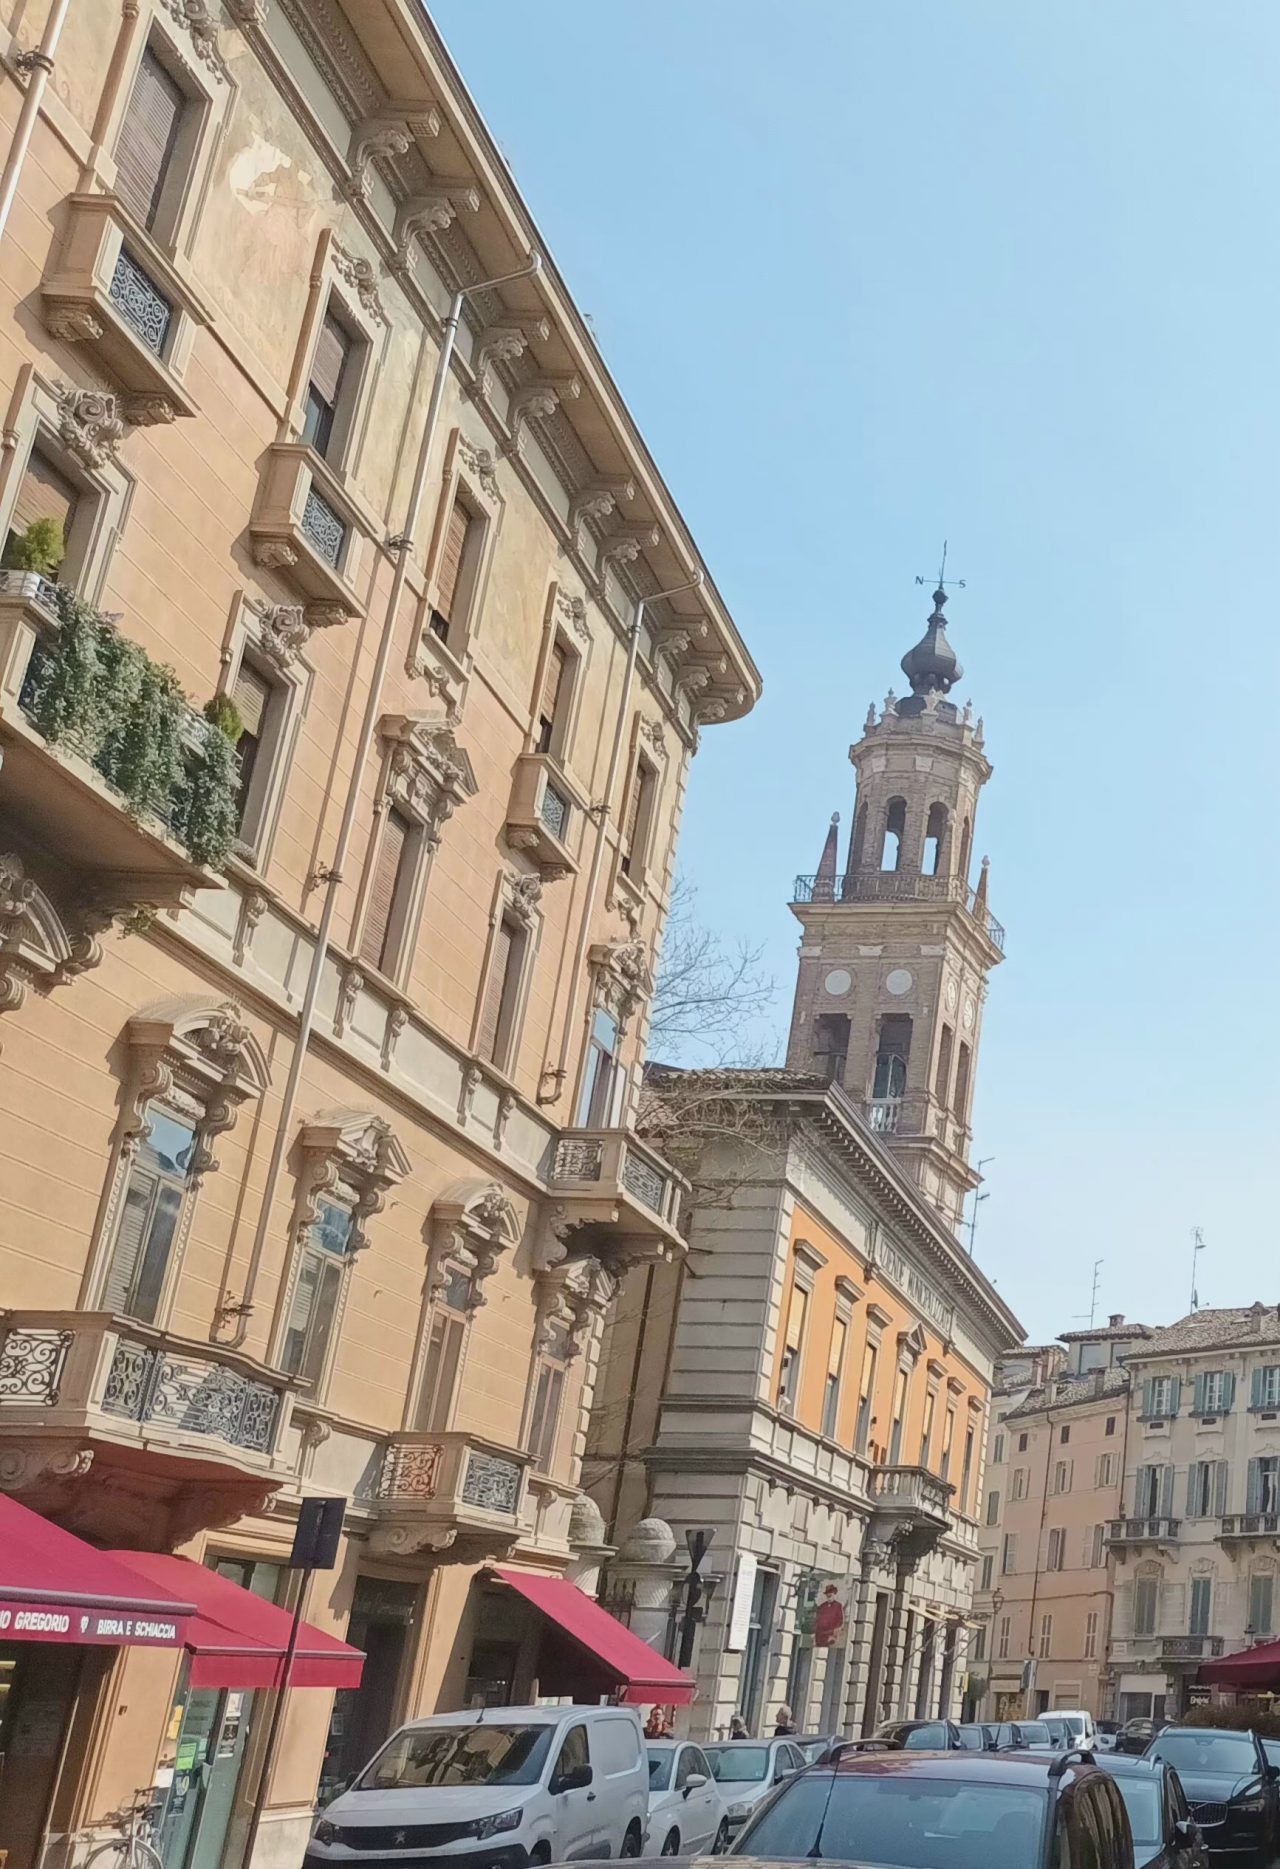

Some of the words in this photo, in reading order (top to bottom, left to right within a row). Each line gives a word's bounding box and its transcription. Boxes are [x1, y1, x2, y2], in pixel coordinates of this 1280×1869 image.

[14, 1611, 70, 1633] GREGORIO
[96, 1619, 124, 1636] BIRRA
[125, 1620, 133, 1636] E
[134, 1621, 176, 1639] SCHIACCIA
